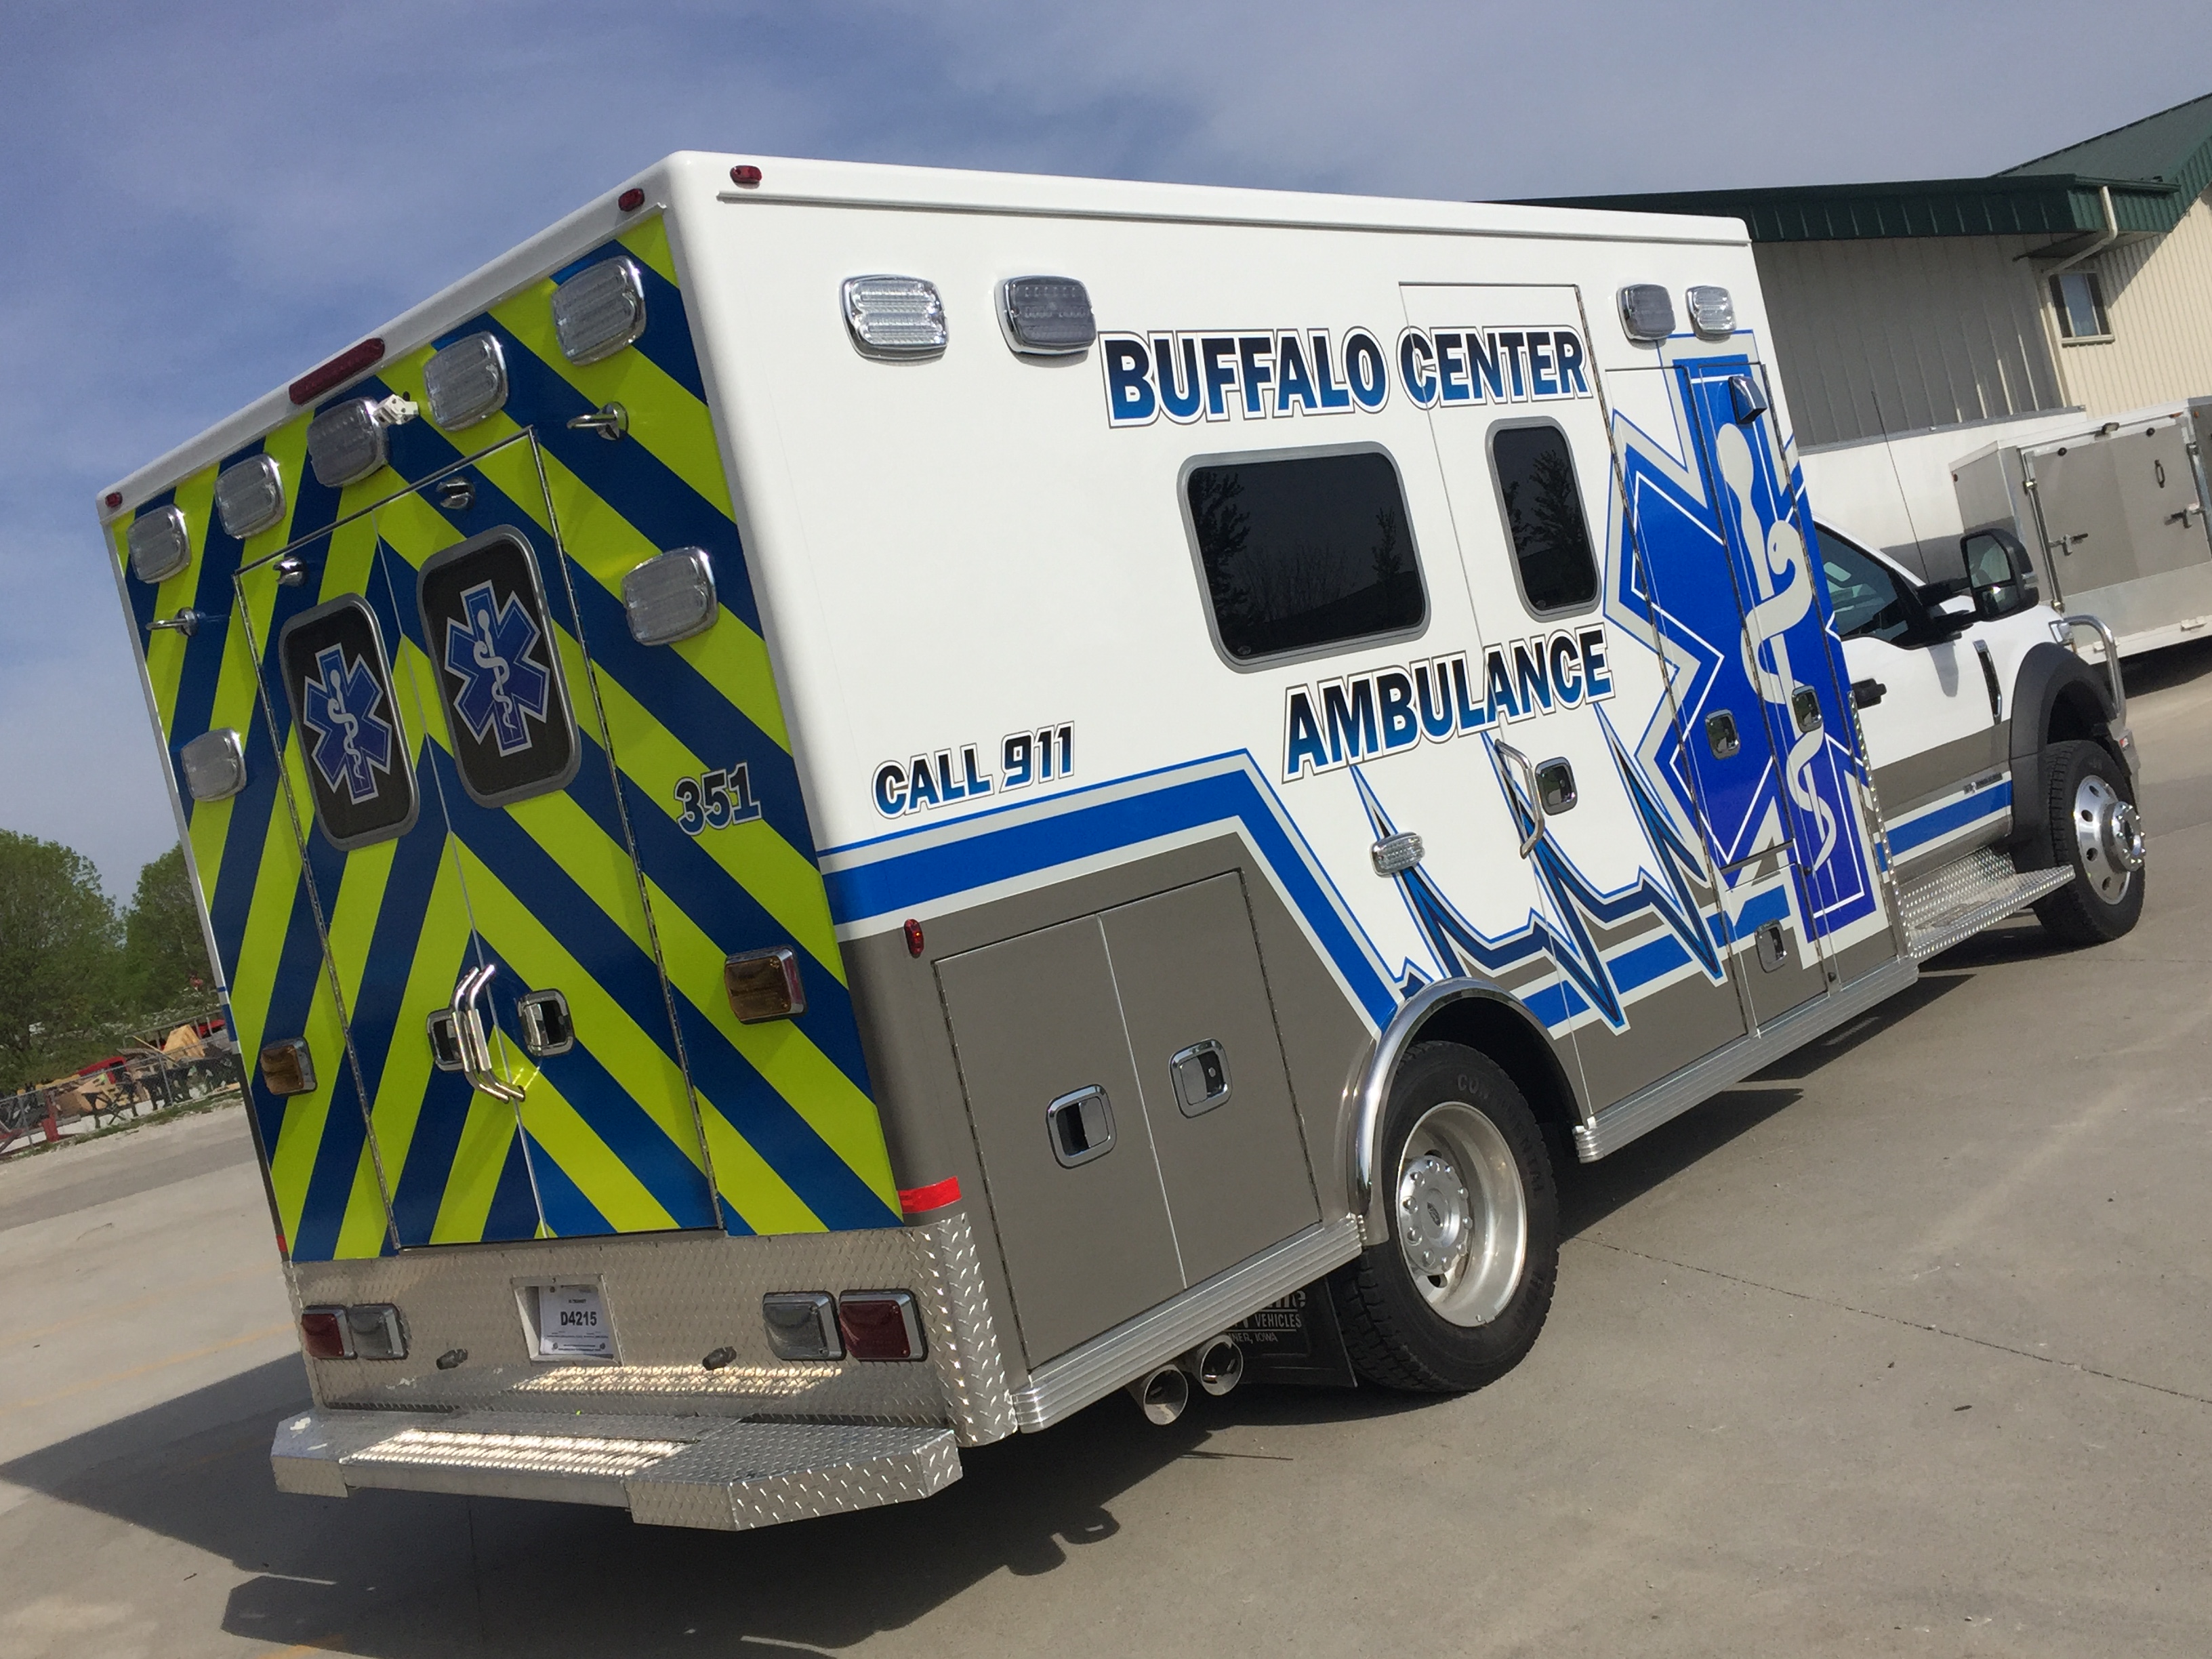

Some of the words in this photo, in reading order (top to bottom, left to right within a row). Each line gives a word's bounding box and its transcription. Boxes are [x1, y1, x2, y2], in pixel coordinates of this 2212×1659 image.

[1098, 326, 1391, 428] BUFFALO
[1396, 325, 1593, 410] CENTER
[1282, 622, 1616, 784] AMBULANCE
[673, 760, 762, 836] 351
[872, 743, 994, 819] CALL
[999, 720, 1074, 793] 911
[560, 1311, 597, 1326] D4215
[1254, 1313, 1302, 1328] VEHICLES
[1254, 1332, 1279, 1342] IOWA
